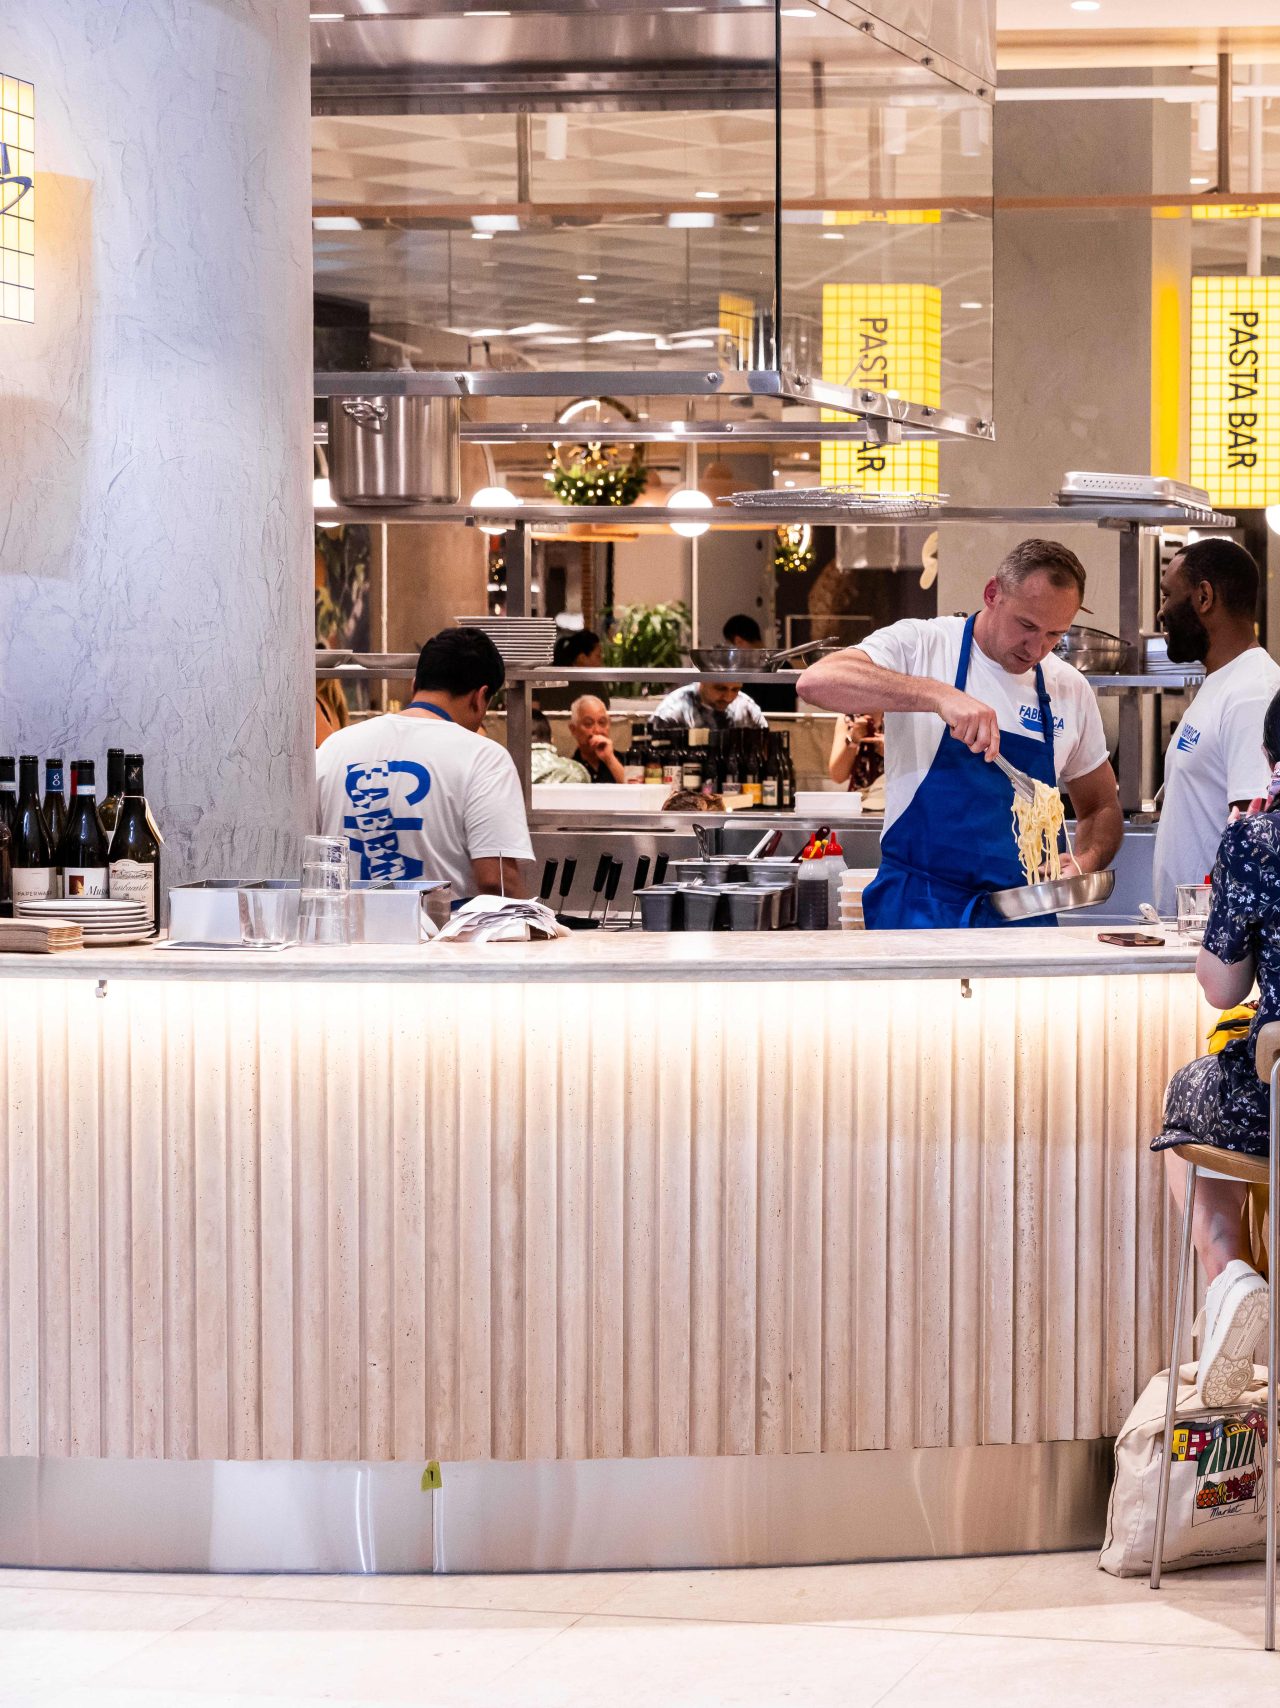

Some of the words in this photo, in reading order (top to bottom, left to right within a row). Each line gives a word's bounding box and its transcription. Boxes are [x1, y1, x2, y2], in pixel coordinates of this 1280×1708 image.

[859, 317, 888, 389] PAST
[1228, 312, 1259, 402] PASTA
[856, 440, 886, 473] AR
[1227, 412, 1258, 469] BAR
[1018, 704, 1065, 730] FABBCA
[343, 760, 431, 881] CIA
[1209, 1503, 1245, 1519] Market
